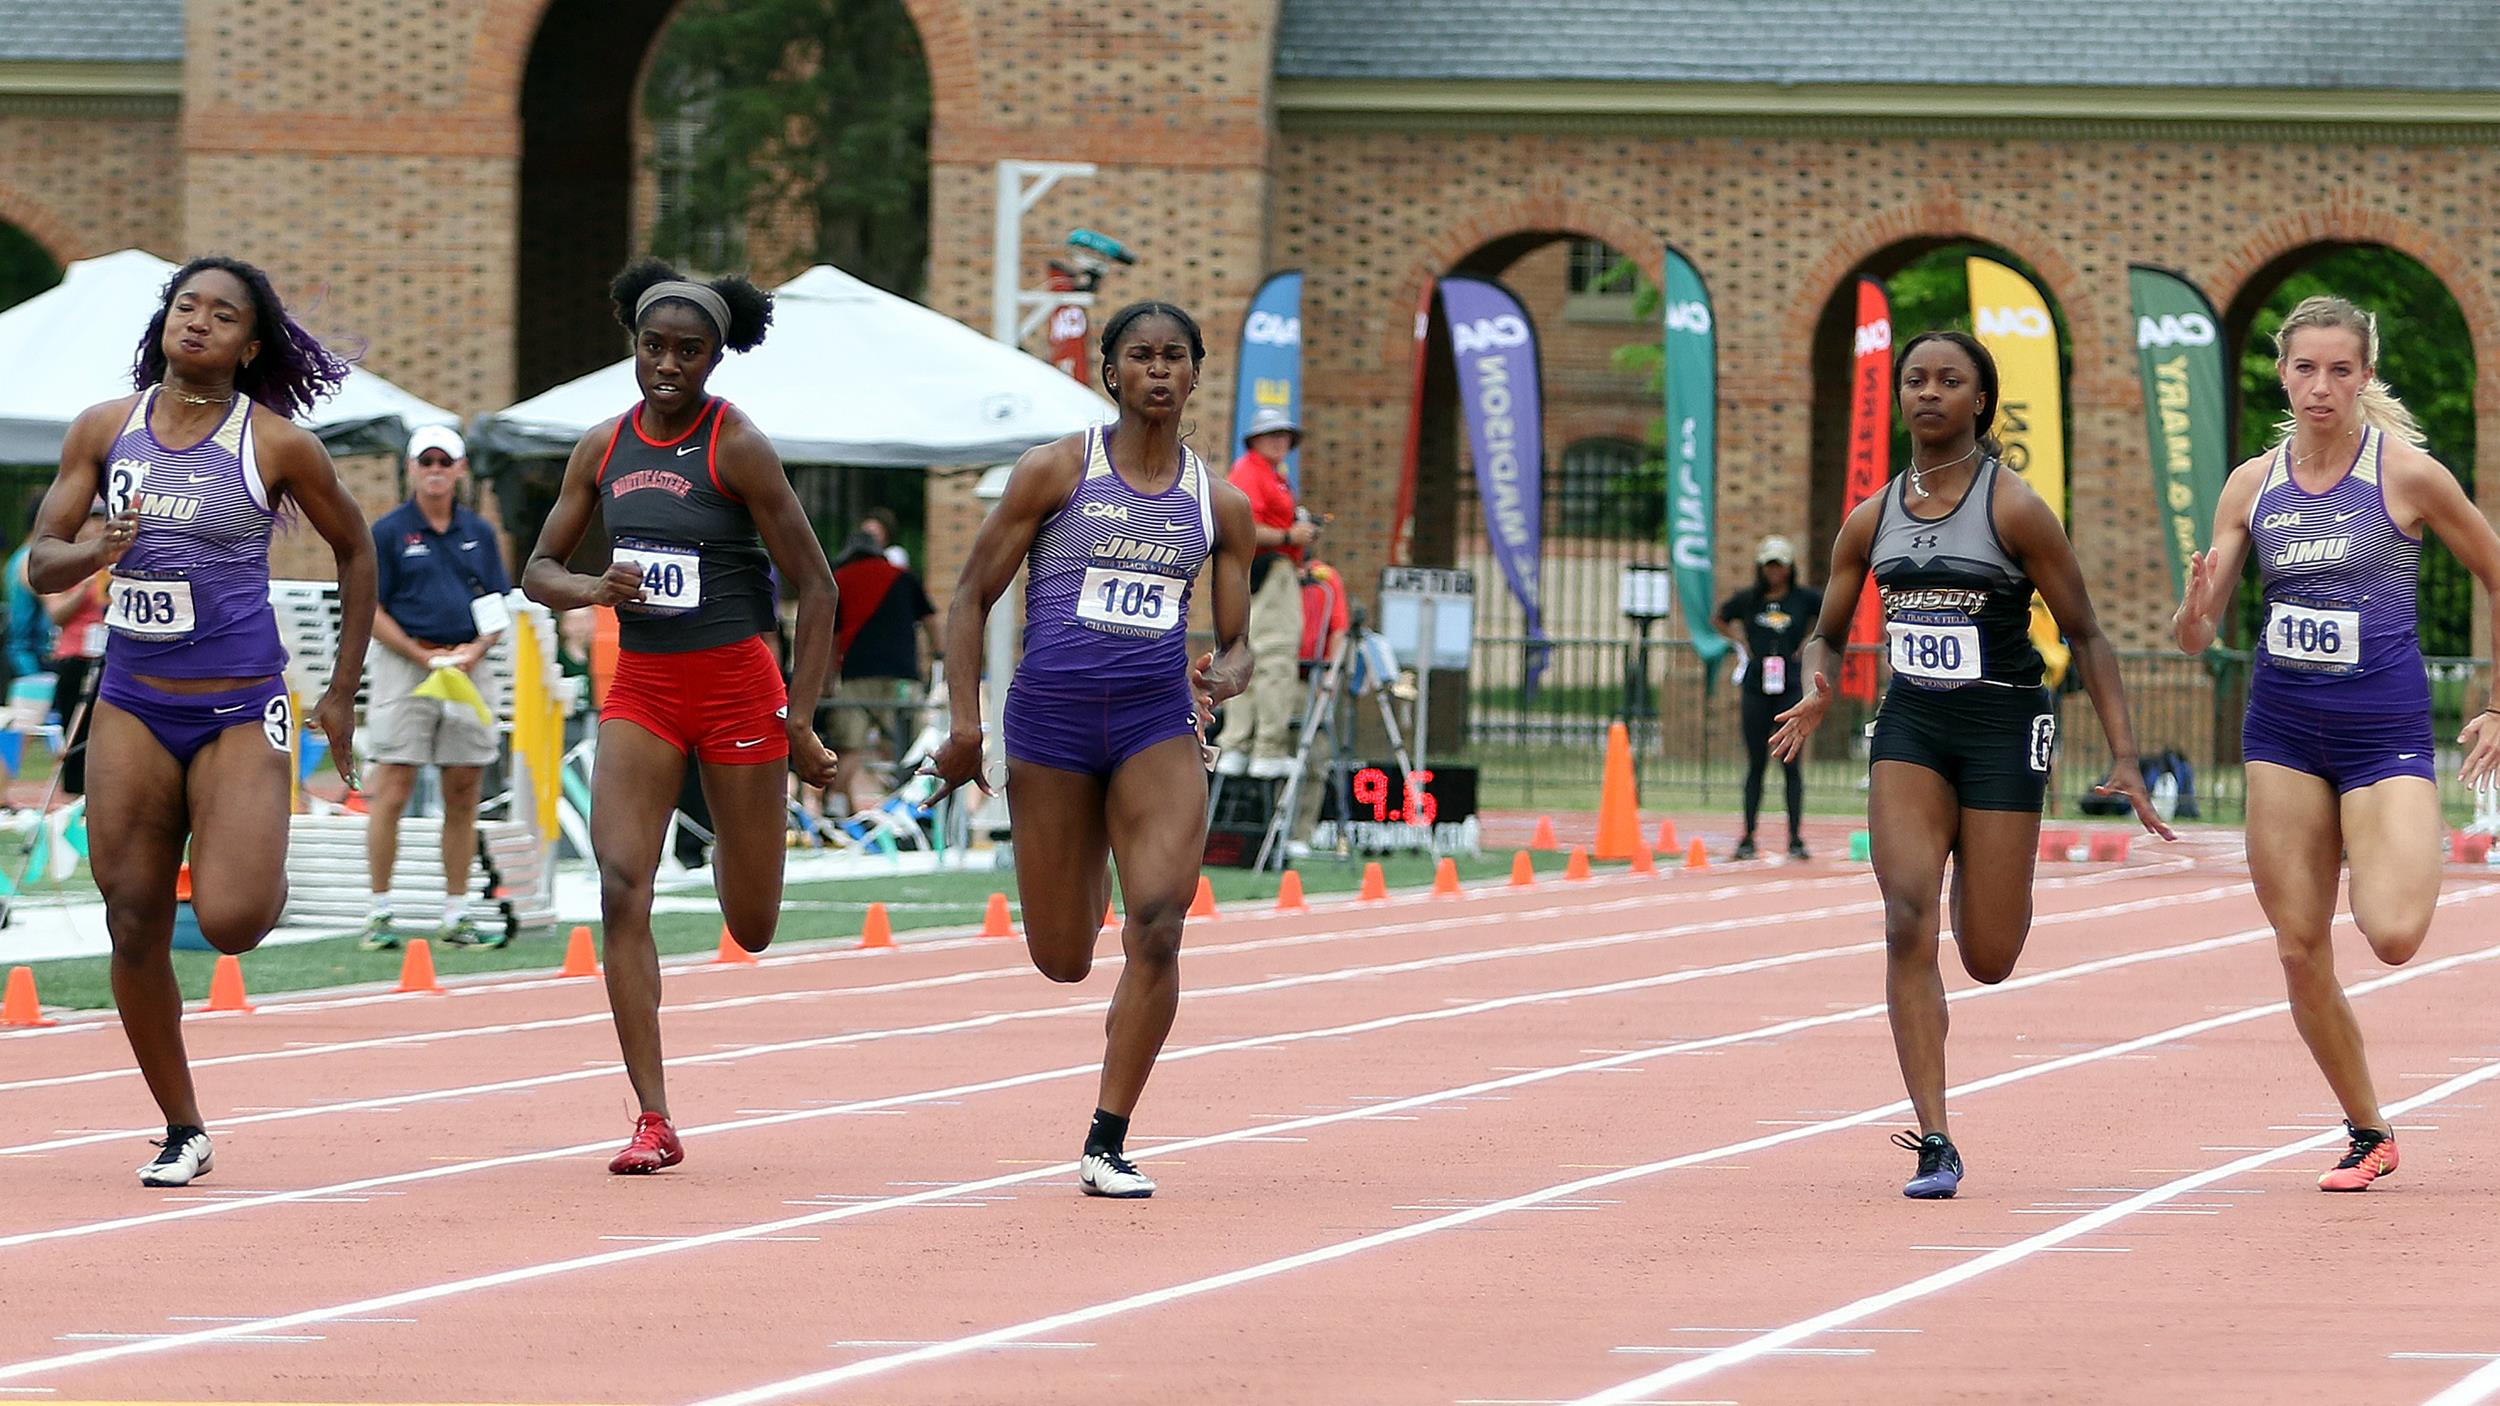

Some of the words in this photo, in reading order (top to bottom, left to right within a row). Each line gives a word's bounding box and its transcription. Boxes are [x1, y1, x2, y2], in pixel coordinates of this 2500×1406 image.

[111, 469, 133, 514] 3
[139, 492, 202, 523] MU
[1082, 502, 1129, 520] CAA
[2263, 512, 2301, 529] CAA
[1092, 534, 1181, 565] JMU
[2275, 536, 2350, 567] JMU
[644, 562, 684, 598] 40
[1103, 578, 1165, 618] 105
[122, 586, 175, 624] 103
[1085, 621, 1164, 639] CHAMPIONSHIP
[2281, 615, 2340, 654] 106
[1904, 632, 1961, 670] 180
[267, 699, 290, 747] 3
[1353, 767, 1438, 826] 9.6
